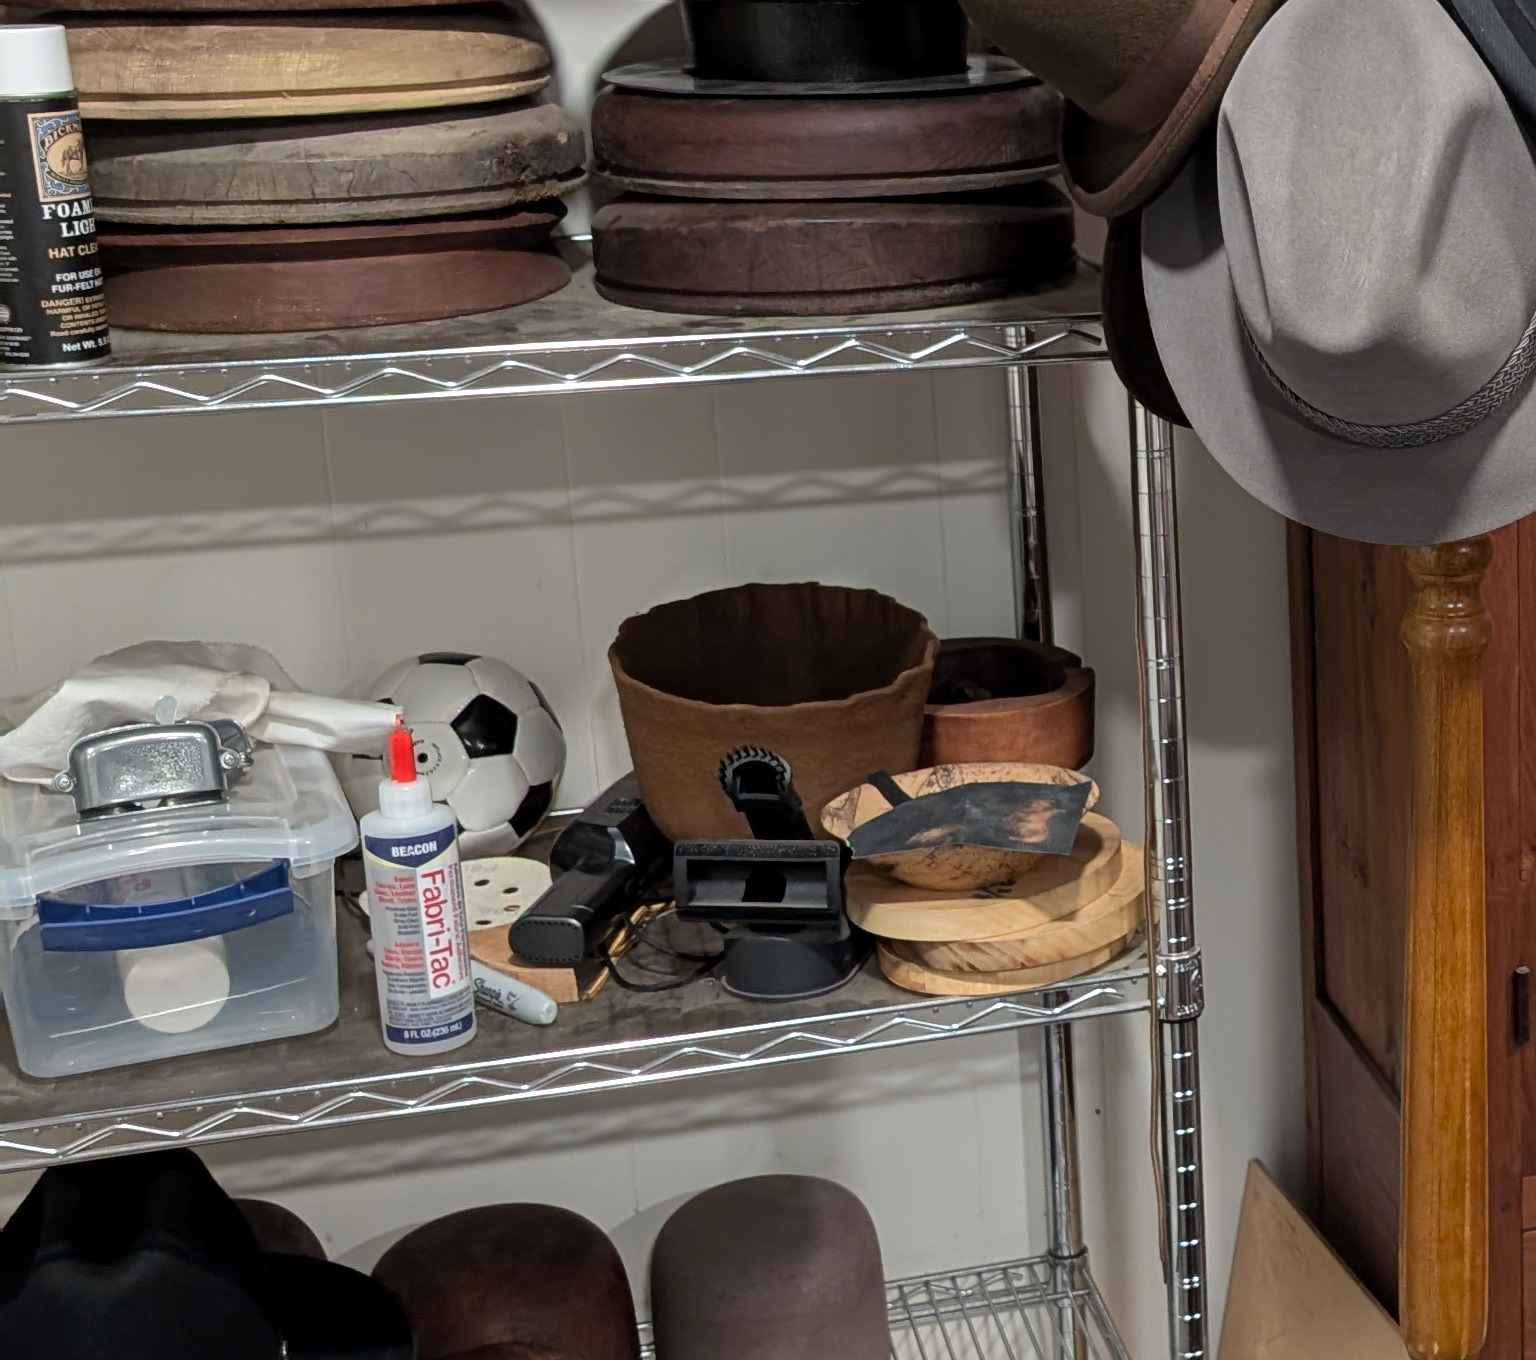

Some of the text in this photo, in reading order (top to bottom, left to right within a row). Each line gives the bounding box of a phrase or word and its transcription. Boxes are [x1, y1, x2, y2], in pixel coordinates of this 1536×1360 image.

[60, 218, 97, 238] LIGH
[48, 246, 76, 259] HAT
[56, 272, 78, 282] FOR
[51, 280, 94, 294] FUR-FELT
[62, 342, 82, 353] Net
[391, 840, 437, 858] BEACON
[420, 868, 453, 990] Fabri-Tac
[410, 1029, 420, 1039] FL
